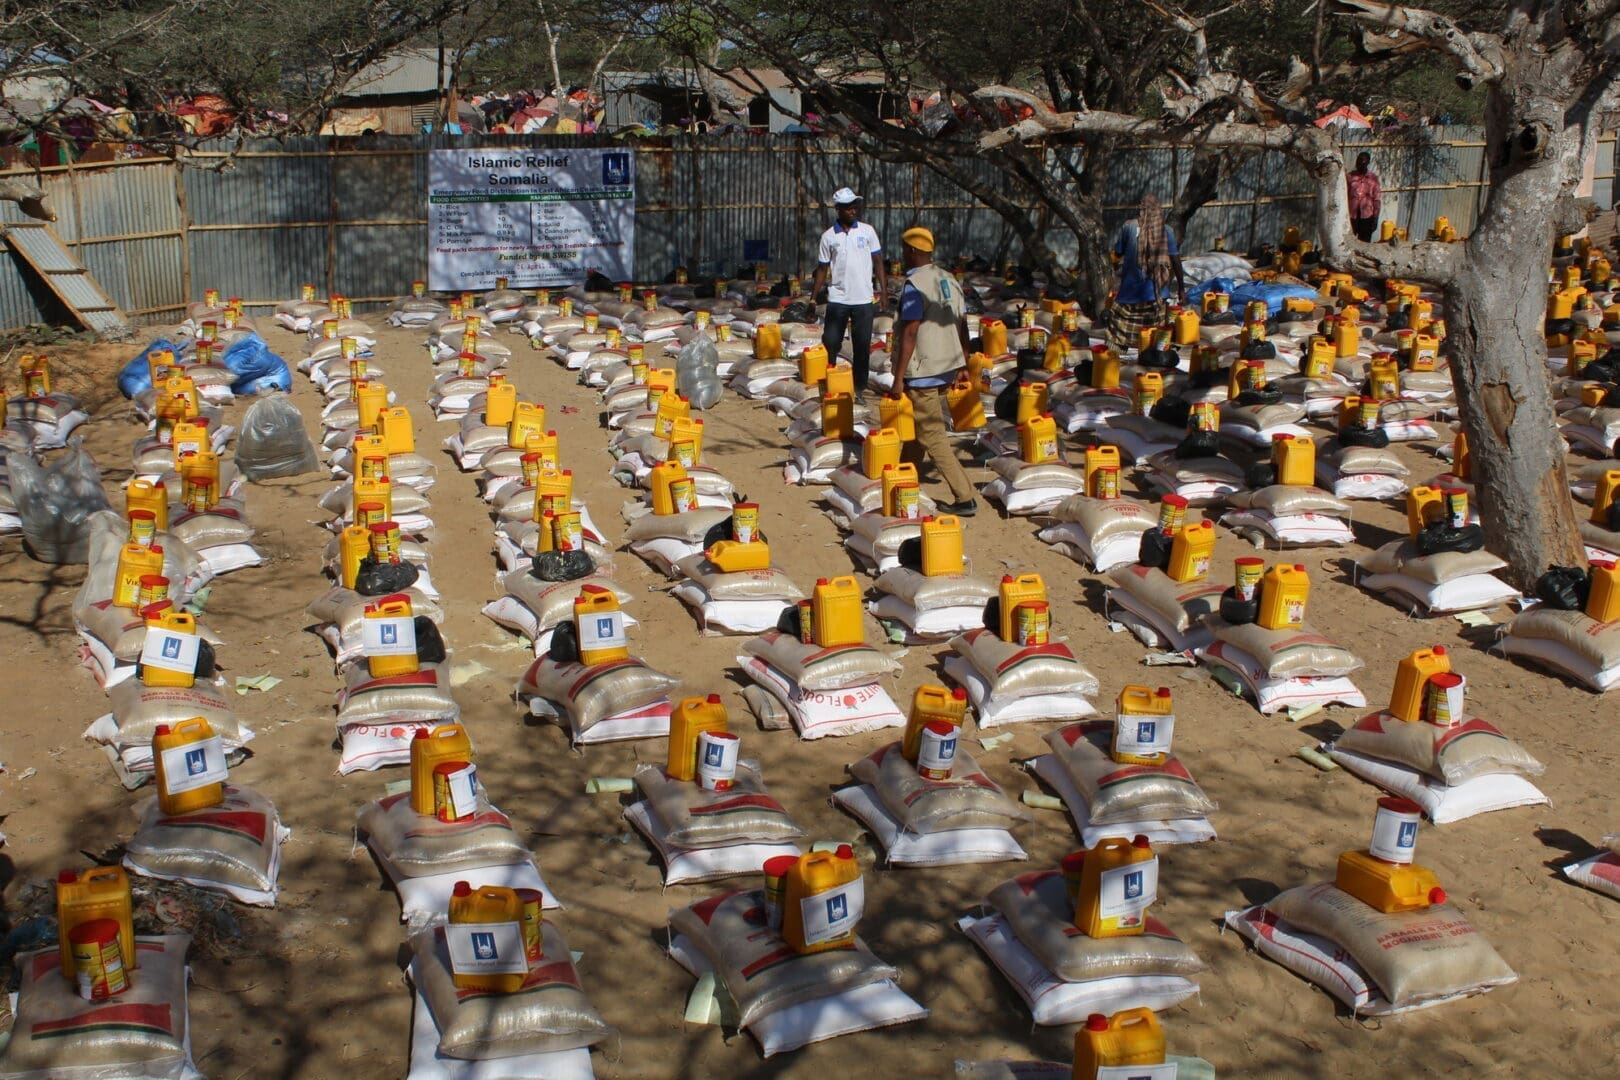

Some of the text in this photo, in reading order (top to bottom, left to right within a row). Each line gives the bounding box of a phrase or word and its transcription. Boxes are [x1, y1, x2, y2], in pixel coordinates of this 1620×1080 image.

[468, 155, 569, 168] Islamic Relief
[489, 173, 549, 186] Somalia
[498, 252, 528, 261] Funded
[552, 251, 577, 260] SWISS
